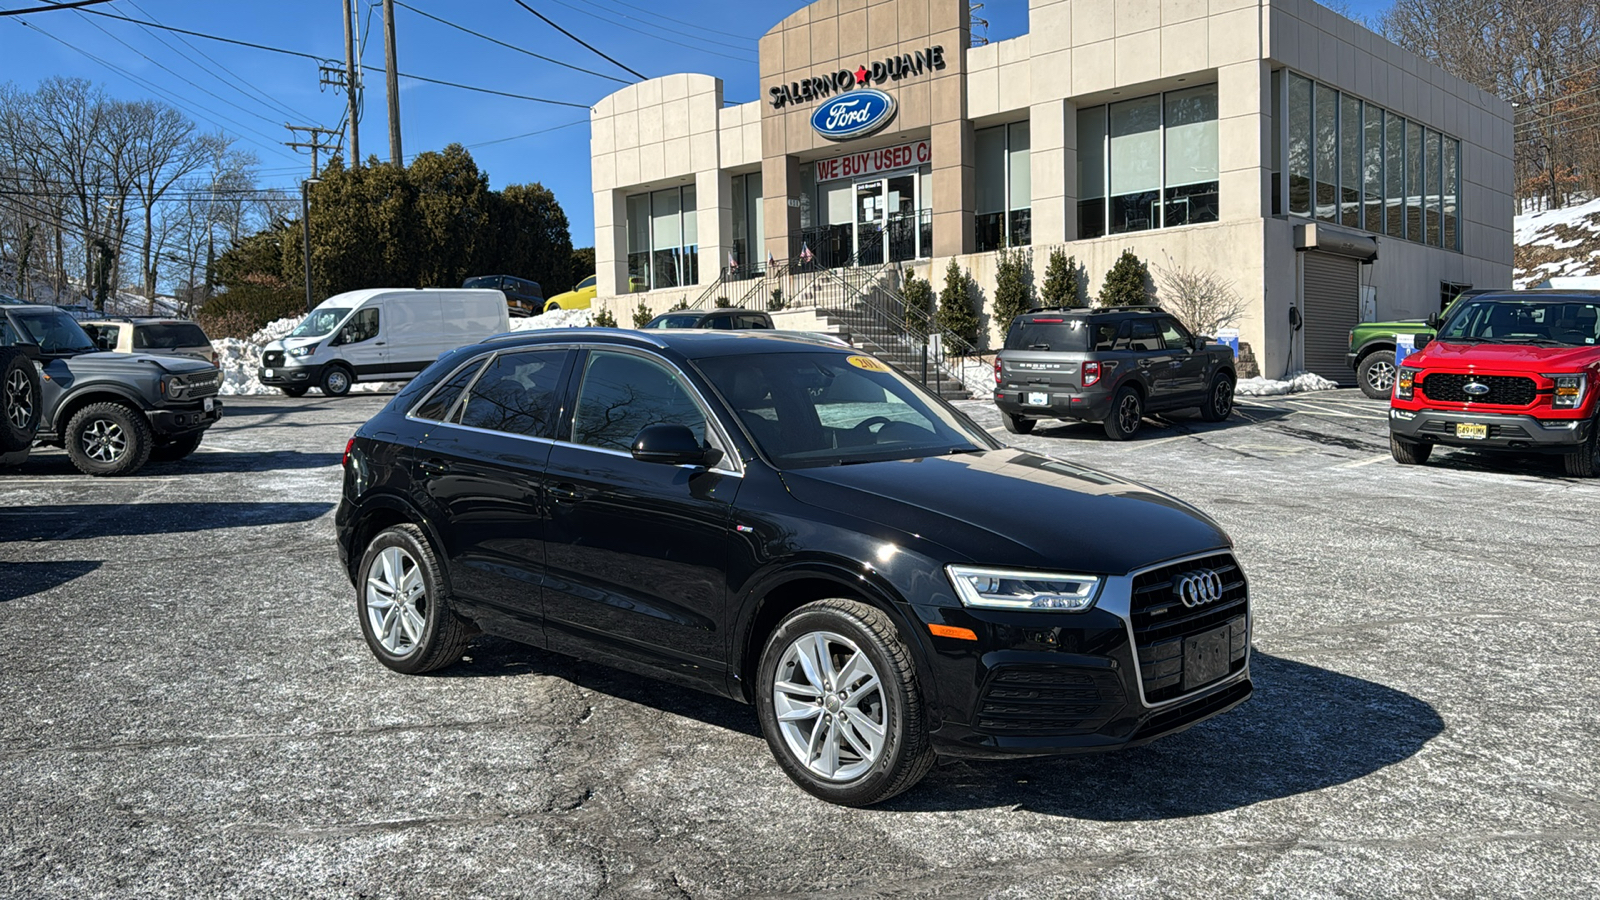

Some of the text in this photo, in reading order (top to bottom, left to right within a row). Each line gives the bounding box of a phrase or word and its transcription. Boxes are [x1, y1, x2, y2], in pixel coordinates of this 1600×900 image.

[769, 45, 945, 109] SALERNO DUANE
[826, 99, 871, 129] Ford
[817, 159, 838, 180] WE
[843, 153, 869, 176] BUY
[874, 145, 912, 170] USED
